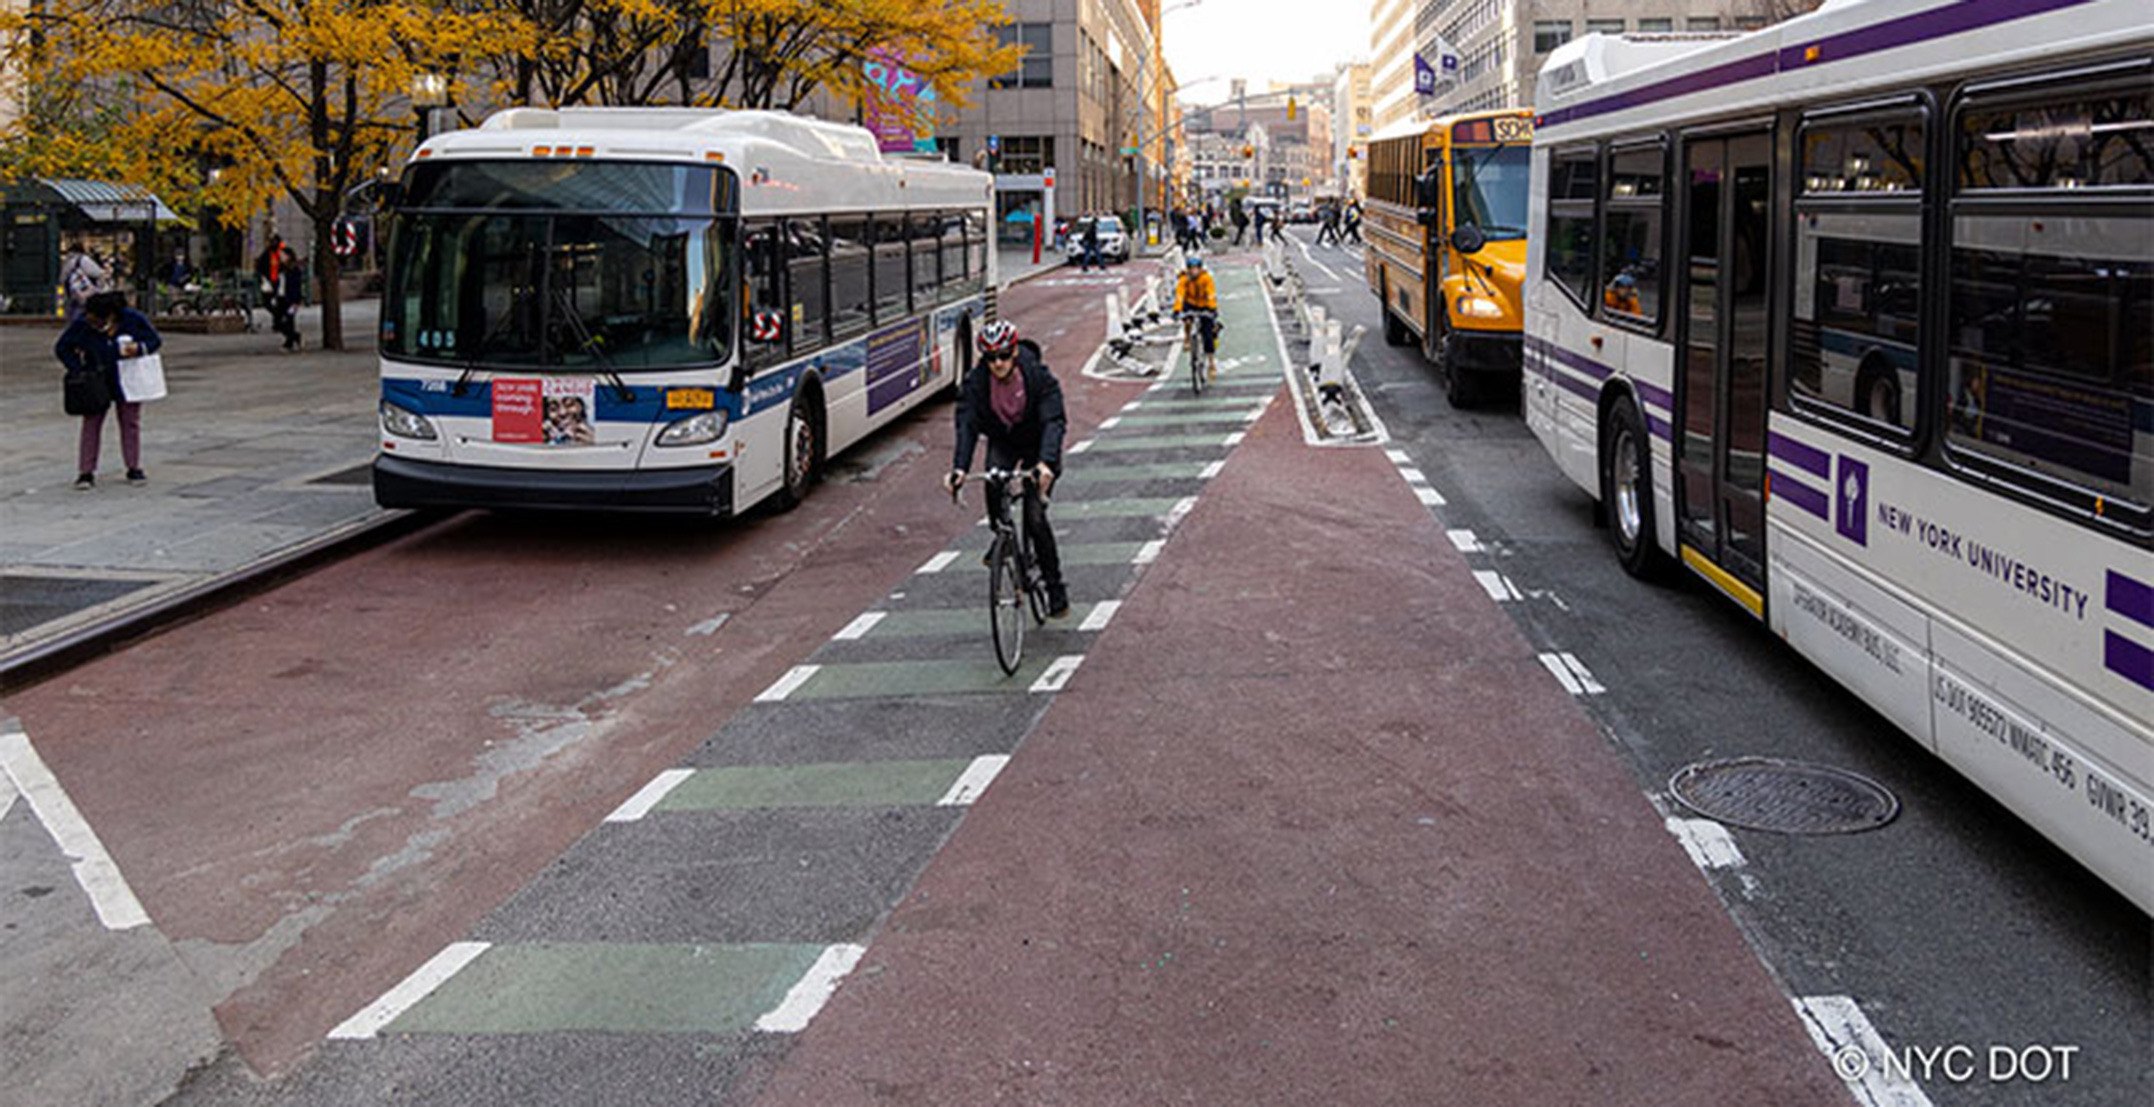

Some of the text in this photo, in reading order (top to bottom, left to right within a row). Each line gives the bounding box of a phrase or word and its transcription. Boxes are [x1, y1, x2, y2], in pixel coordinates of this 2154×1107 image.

[1878, 502, 2089, 620] NEW YORK UNIVERSITY
[2050, 751, 2076, 790] 456
[2086, 773, 2128, 826] GVWR
